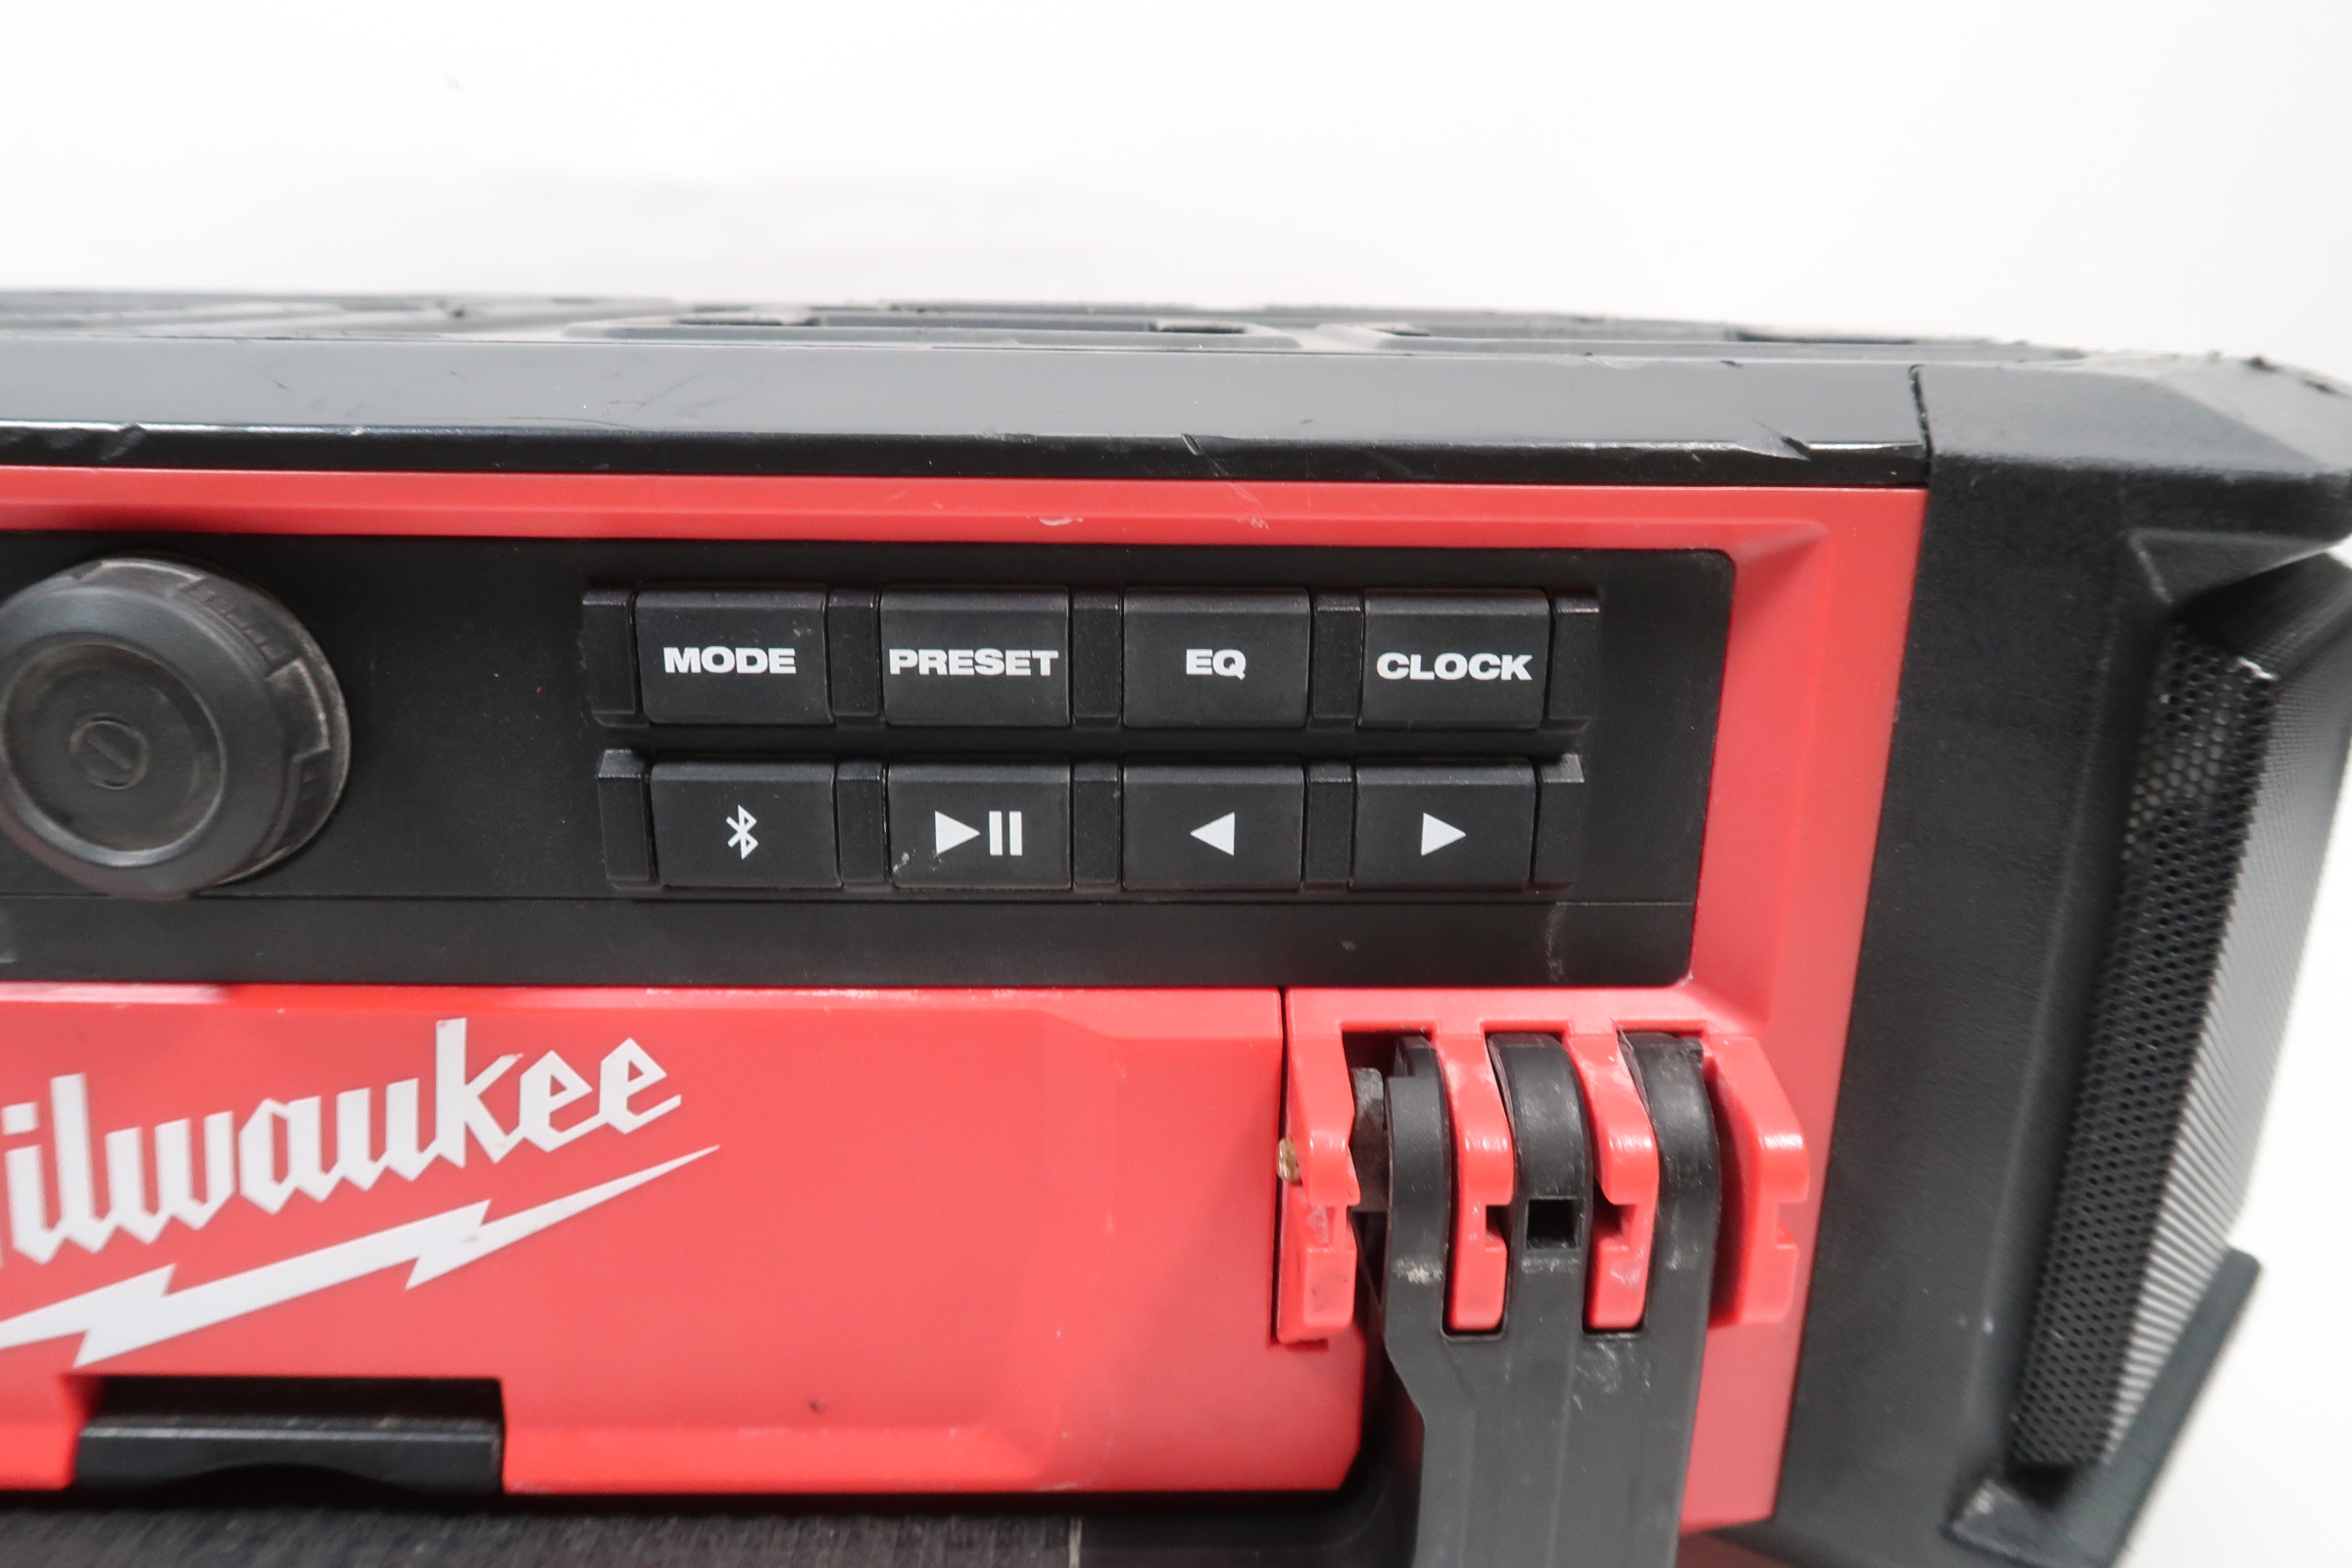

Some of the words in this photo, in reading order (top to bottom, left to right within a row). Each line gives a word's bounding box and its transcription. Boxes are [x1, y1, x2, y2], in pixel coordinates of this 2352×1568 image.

[662, 647, 797, 674] MODE
[888, 647, 1059, 677] PRESET
[1185, 648, 1247, 681] EQ
[1376, 652, 1534, 681] CLOCK
[0, 1017, 682, 1267] ilwaukee
